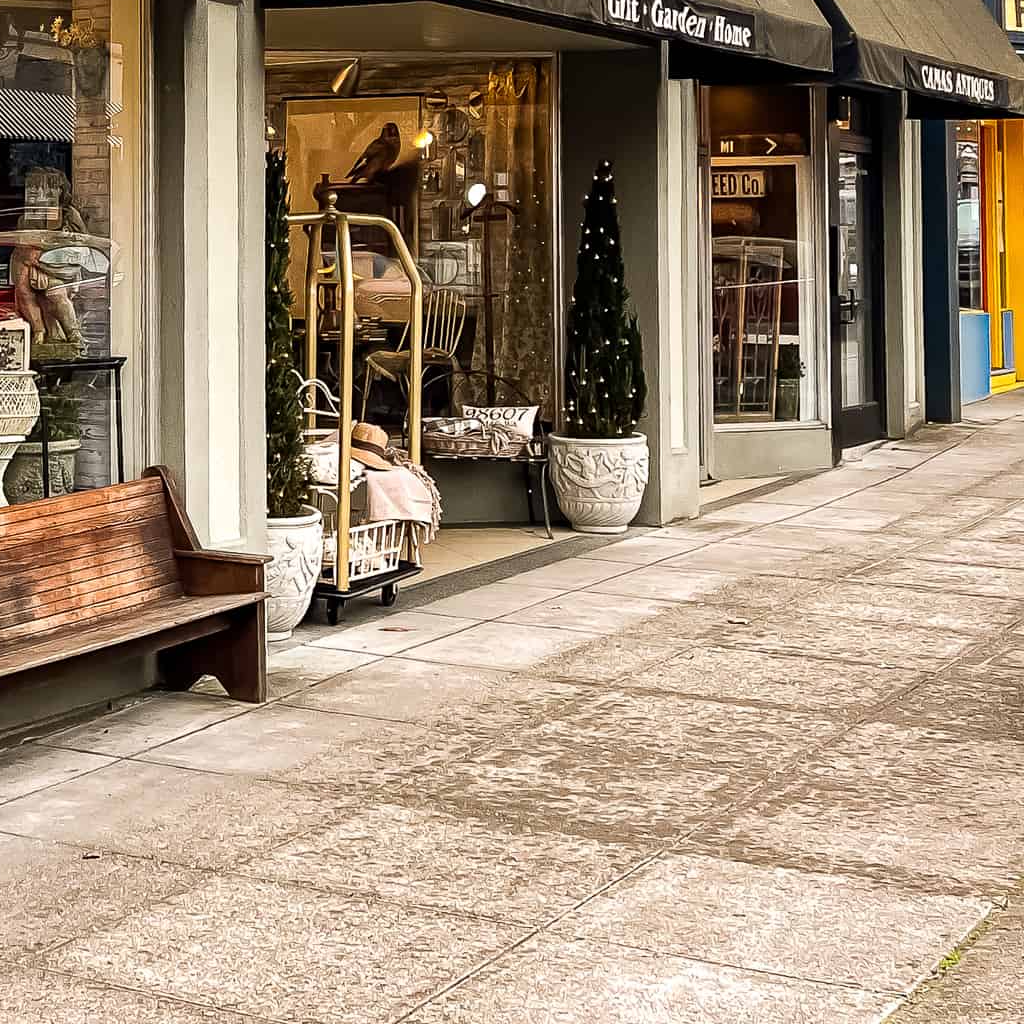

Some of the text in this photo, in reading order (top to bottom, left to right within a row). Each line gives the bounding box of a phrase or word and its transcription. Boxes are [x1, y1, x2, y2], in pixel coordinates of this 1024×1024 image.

[713, 14, 752, 48] Home
[921, 65, 994, 103] CAMAS ANTIQUES
